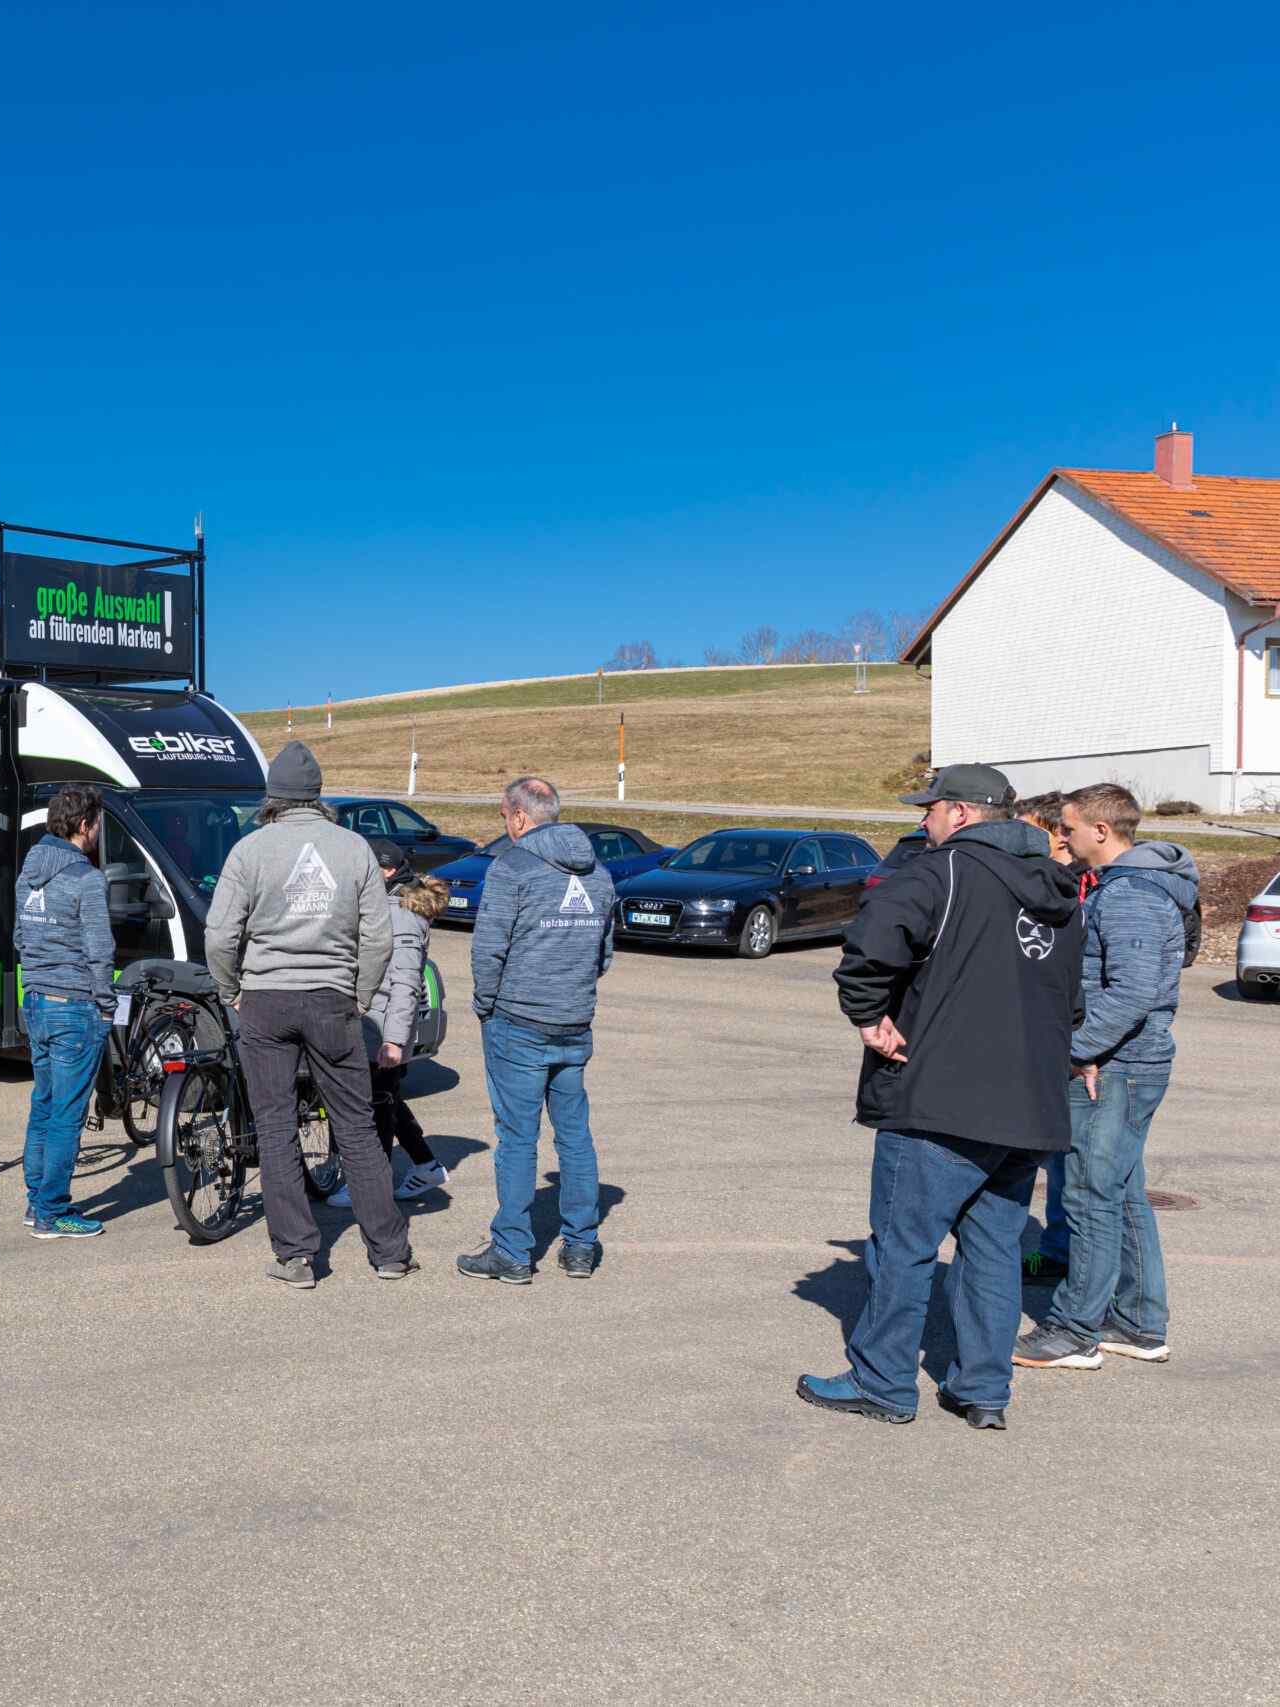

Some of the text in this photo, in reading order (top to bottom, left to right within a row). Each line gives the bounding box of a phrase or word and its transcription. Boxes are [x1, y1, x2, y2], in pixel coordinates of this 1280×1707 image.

[36, 582, 161, 624] große Auswahl
[29, 615, 161, 650] an führenden Marken
[156, 753, 207, 761] LAUFENBURG
